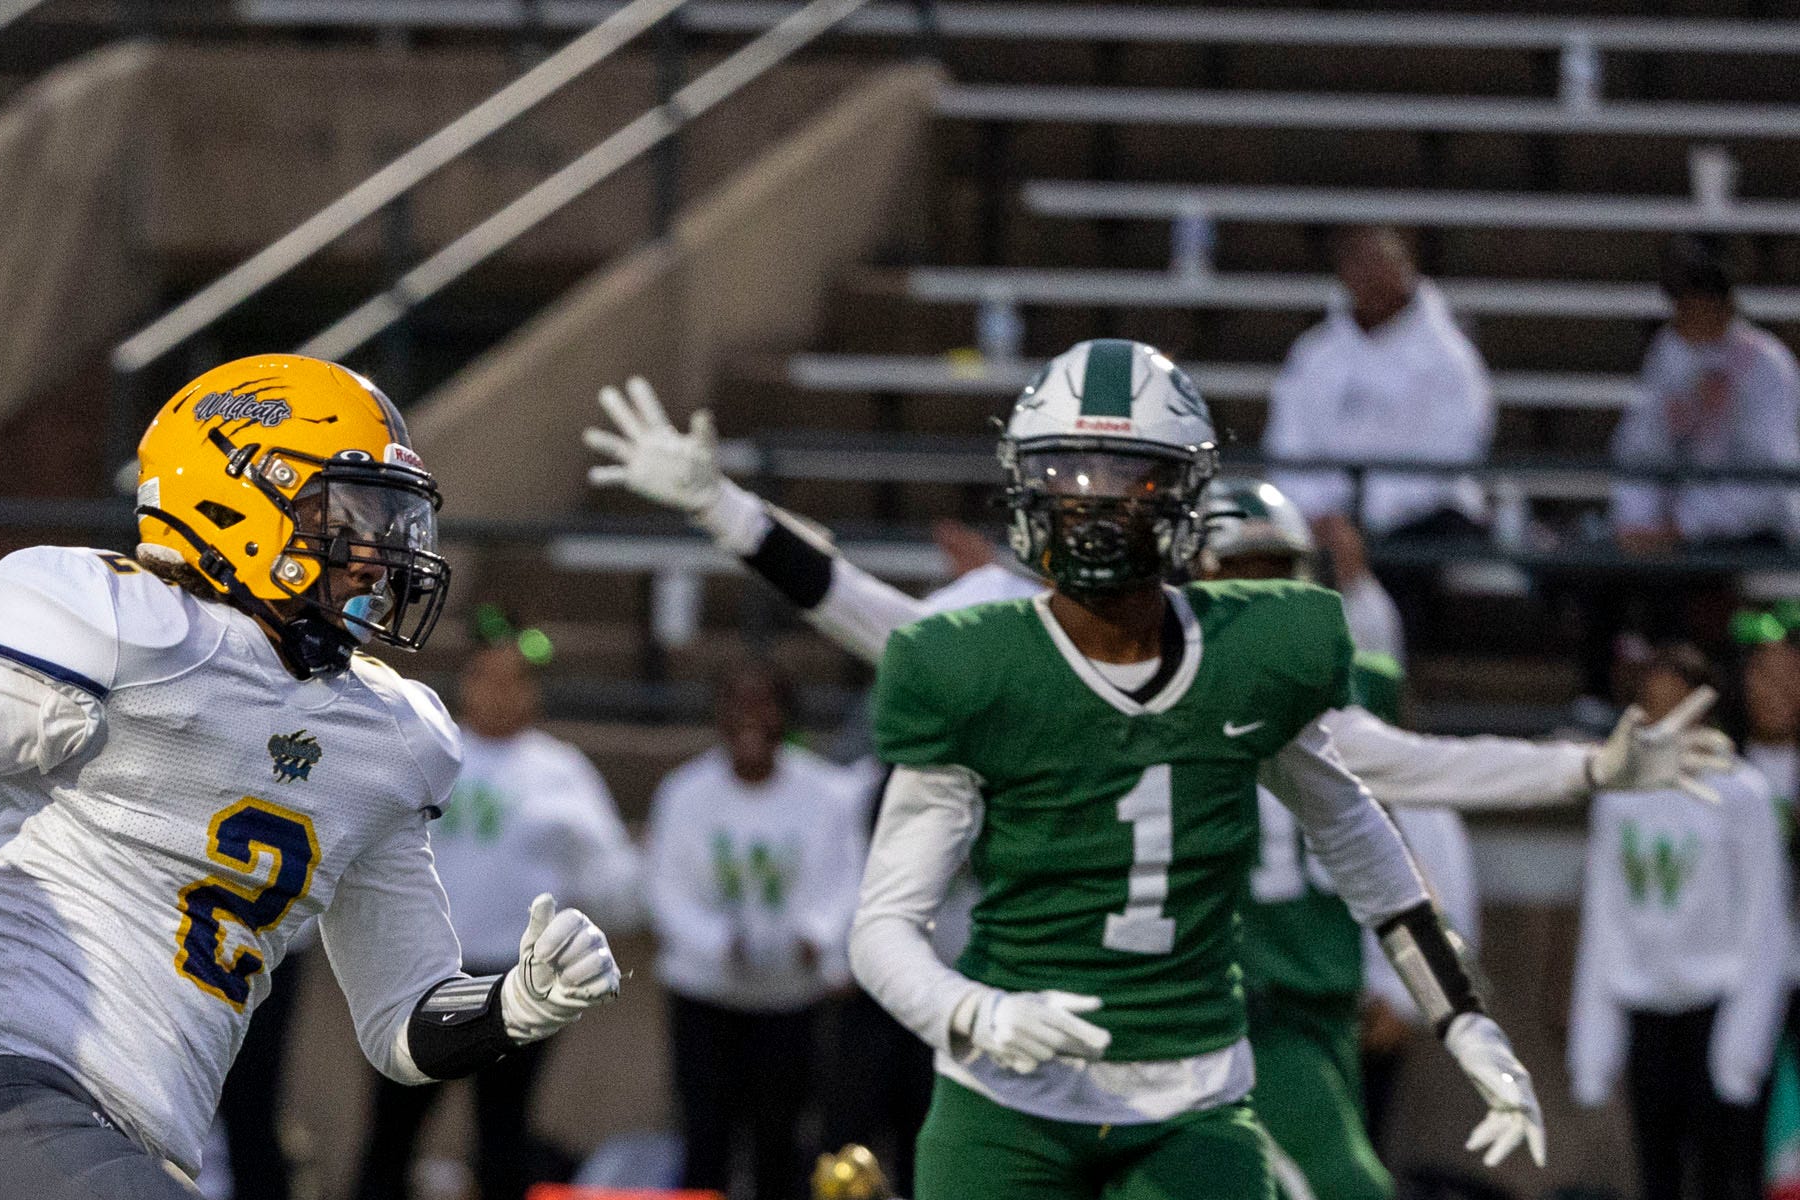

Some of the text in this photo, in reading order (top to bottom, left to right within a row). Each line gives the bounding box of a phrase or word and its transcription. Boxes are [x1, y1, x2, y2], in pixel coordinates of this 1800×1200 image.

[193, 390, 292, 428] Wildcats
[174, 796, 323, 1015] 2
[1102, 762, 1177, 956] 1
[1619, 818, 1700, 909] W
